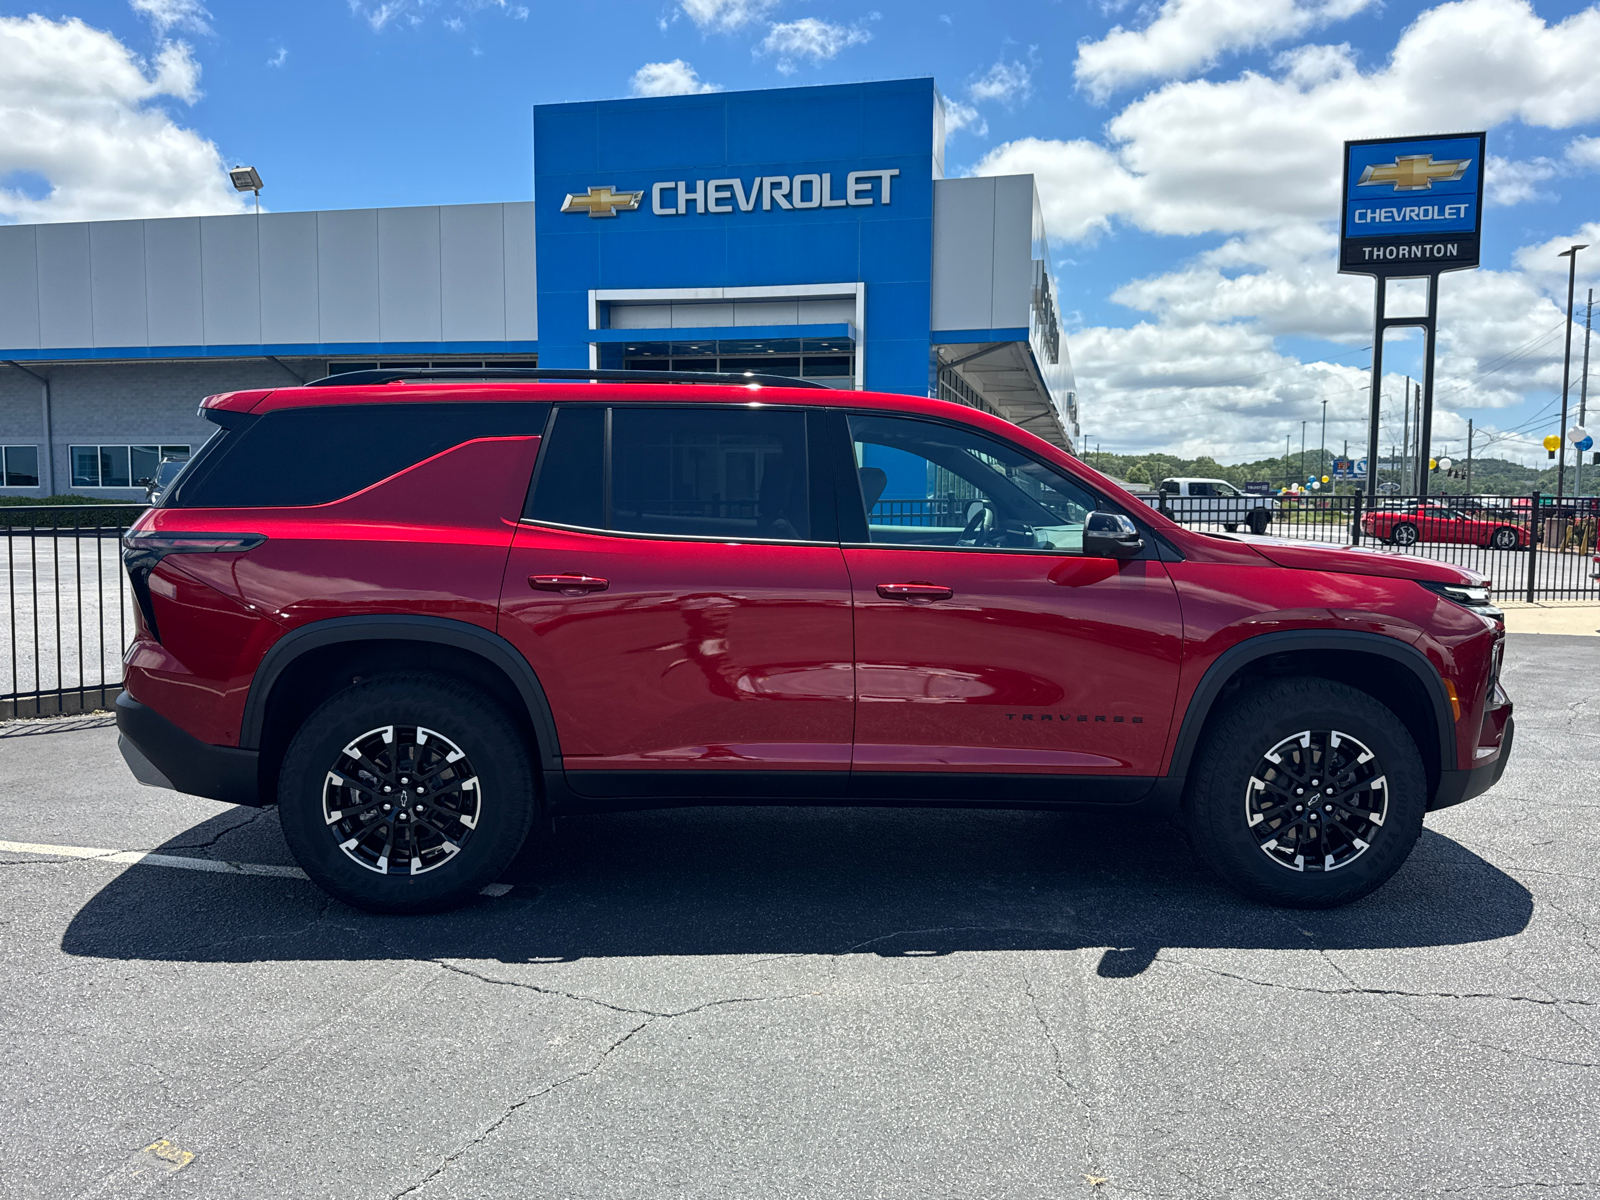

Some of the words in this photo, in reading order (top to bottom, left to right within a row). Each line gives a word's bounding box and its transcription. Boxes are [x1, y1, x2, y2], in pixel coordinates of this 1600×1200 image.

[652, 169, 900, 215] CHEVROLET
[1354, 204, 1469, 223] CHEVROLET
[1362, 243, 1458, 260] THORNTON
[1005, 713, 1143, 723] TRAVERSE
